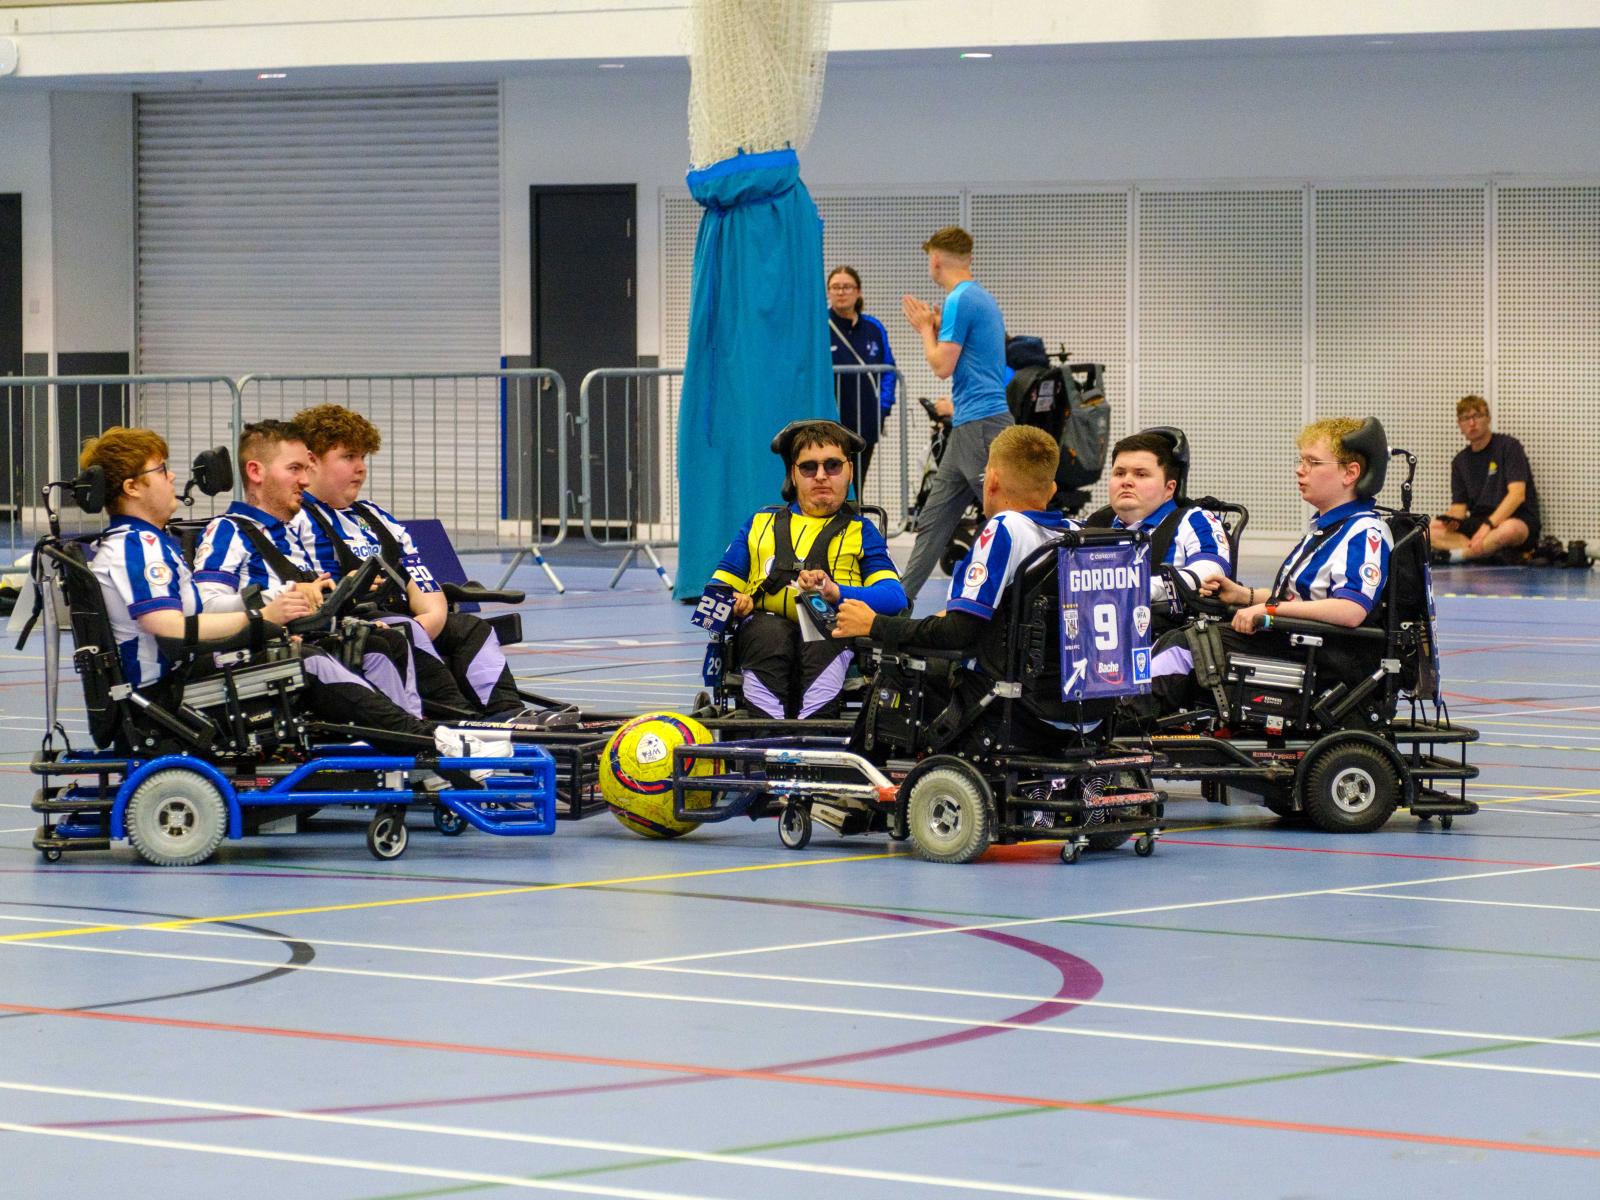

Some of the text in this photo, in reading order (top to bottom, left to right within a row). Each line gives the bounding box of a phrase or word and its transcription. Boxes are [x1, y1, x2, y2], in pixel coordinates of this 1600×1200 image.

[406, 565, 434, 581] 20
[1070, 566, 1140, 592] GORDON
[697, 595, 732, 622] 29
[1093, 603, 1119, 651] 9
[706, 657, 722, 676] 29
[1098, 661, 1119, 674] Bache
